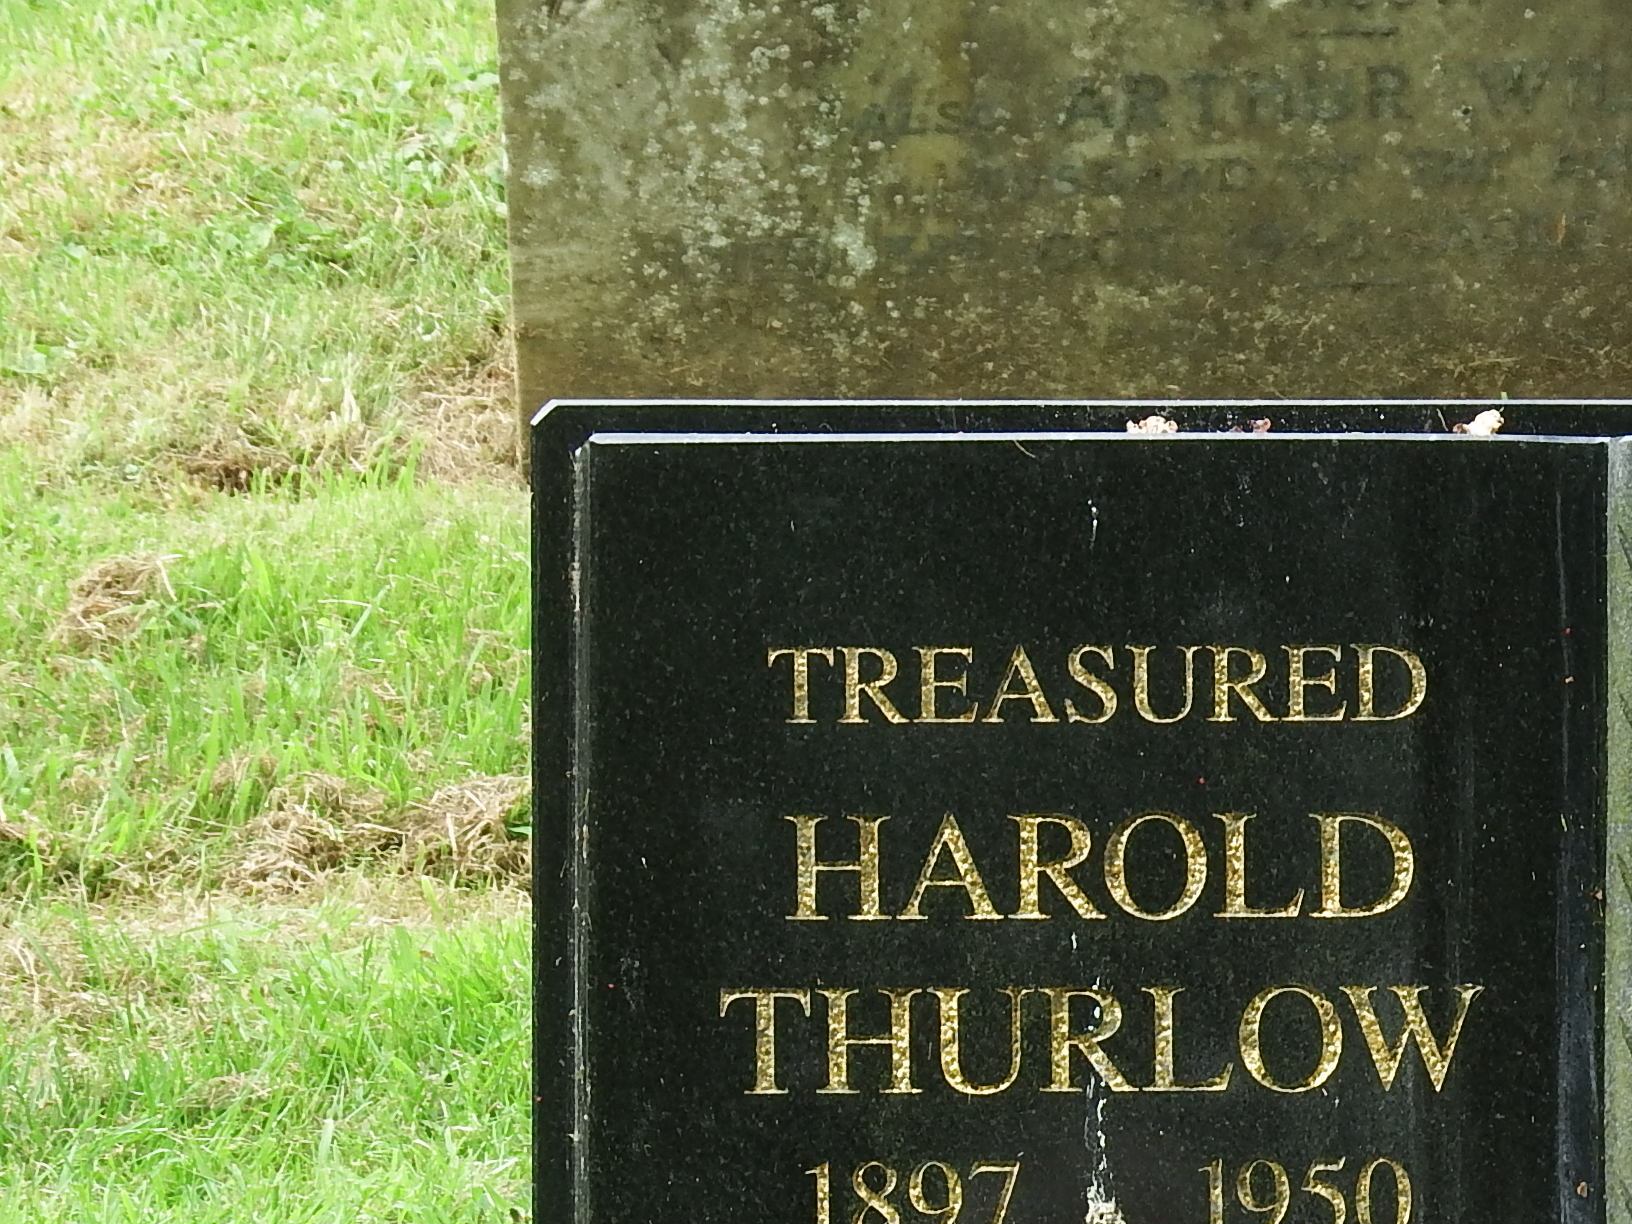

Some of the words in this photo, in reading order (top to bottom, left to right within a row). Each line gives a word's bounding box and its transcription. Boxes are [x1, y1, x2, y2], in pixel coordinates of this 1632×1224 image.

[1060, 62, 1413, 136] ARTHUR
[767, 644, 1427, 724] TREASURED
[784, 812, 1414, 921] HAROLD
[720, 983, 1485, 1095] THURLOW
